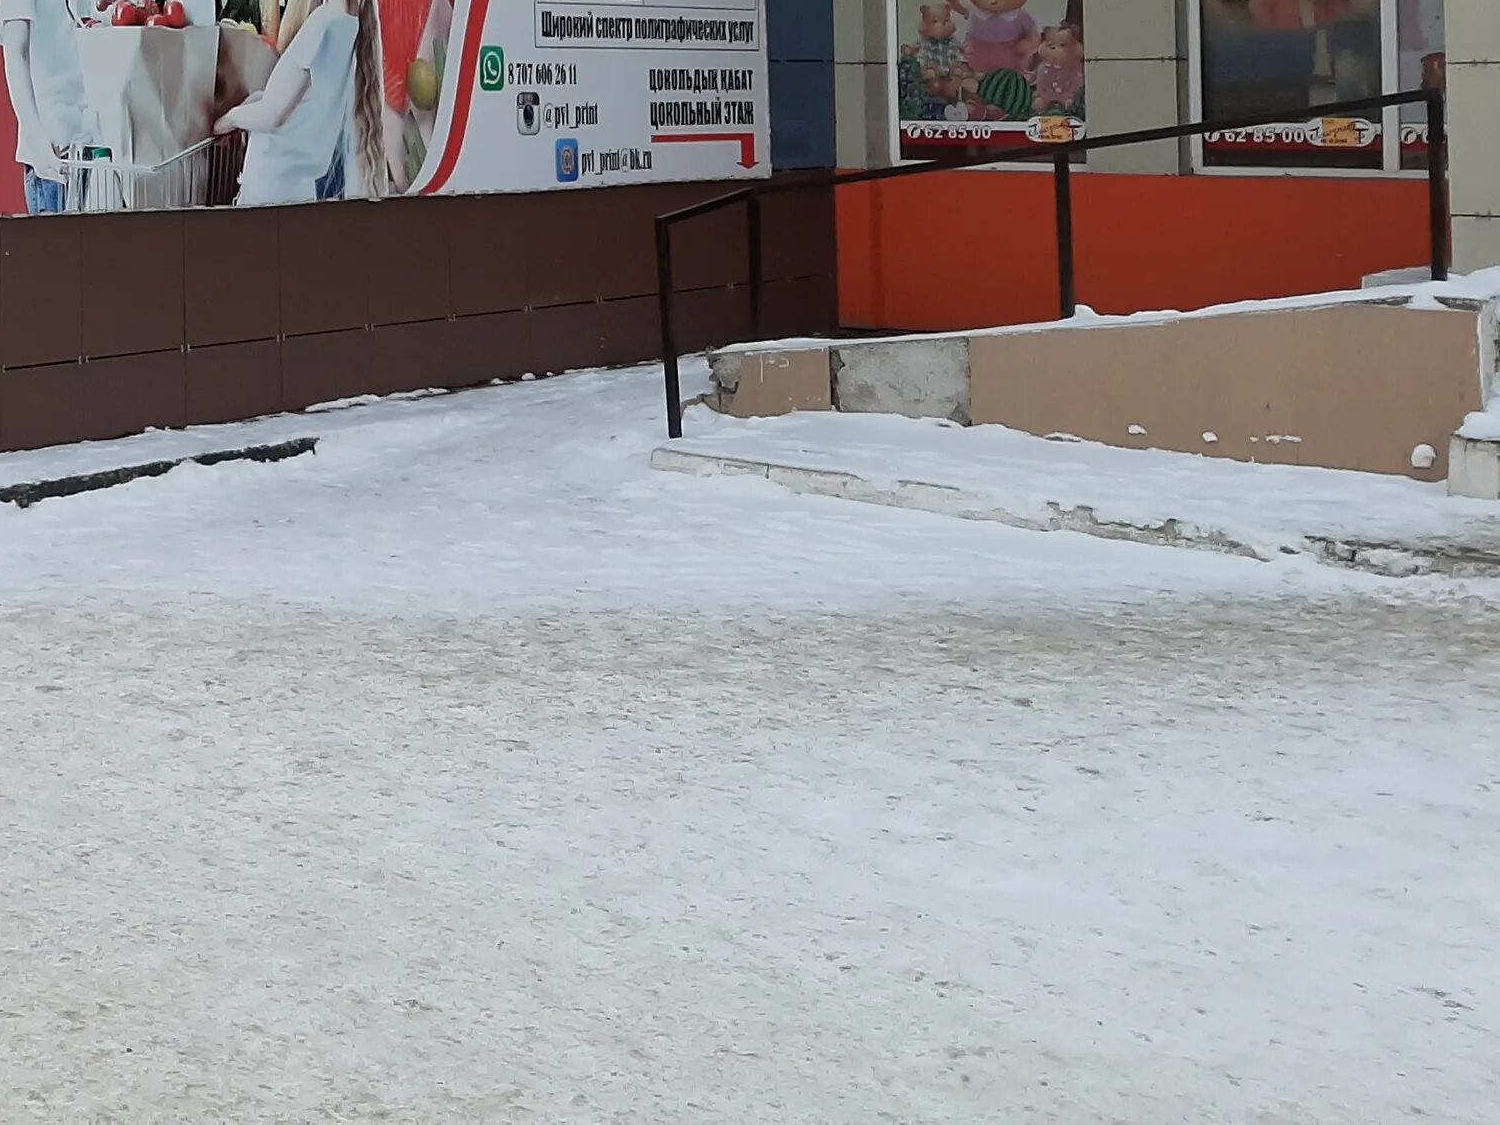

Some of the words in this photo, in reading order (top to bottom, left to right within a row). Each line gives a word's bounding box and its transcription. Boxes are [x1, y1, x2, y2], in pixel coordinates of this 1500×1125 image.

[541, 10, 593, 41] Широкий
[595, 15, 633, 42] спектр
[634, 15, 726, 43] полиграфических
[727, 20, 755, 44] услуг
[507, 63, 514, 85] 8
[516, 63, 533, 85] 707
[555, 63, 567, 85] 26
[568, 63, 578, 85] 11
[720, 69, 754, 93] ҚАБАТ
[650, 96, 722, 130] ЦОКОЛЬНЫЙ
[723, 100, 755, 125] ЭТАЖ
[924, 125, 943, 138] 62
[948, 125, 968, 139] 85
[971, 126, 992, 140] 00
[1224, 128, 1247, 143] 62
[1252, 128, 1276, 143] 85
[1282, 128, 1304, 143] 00
